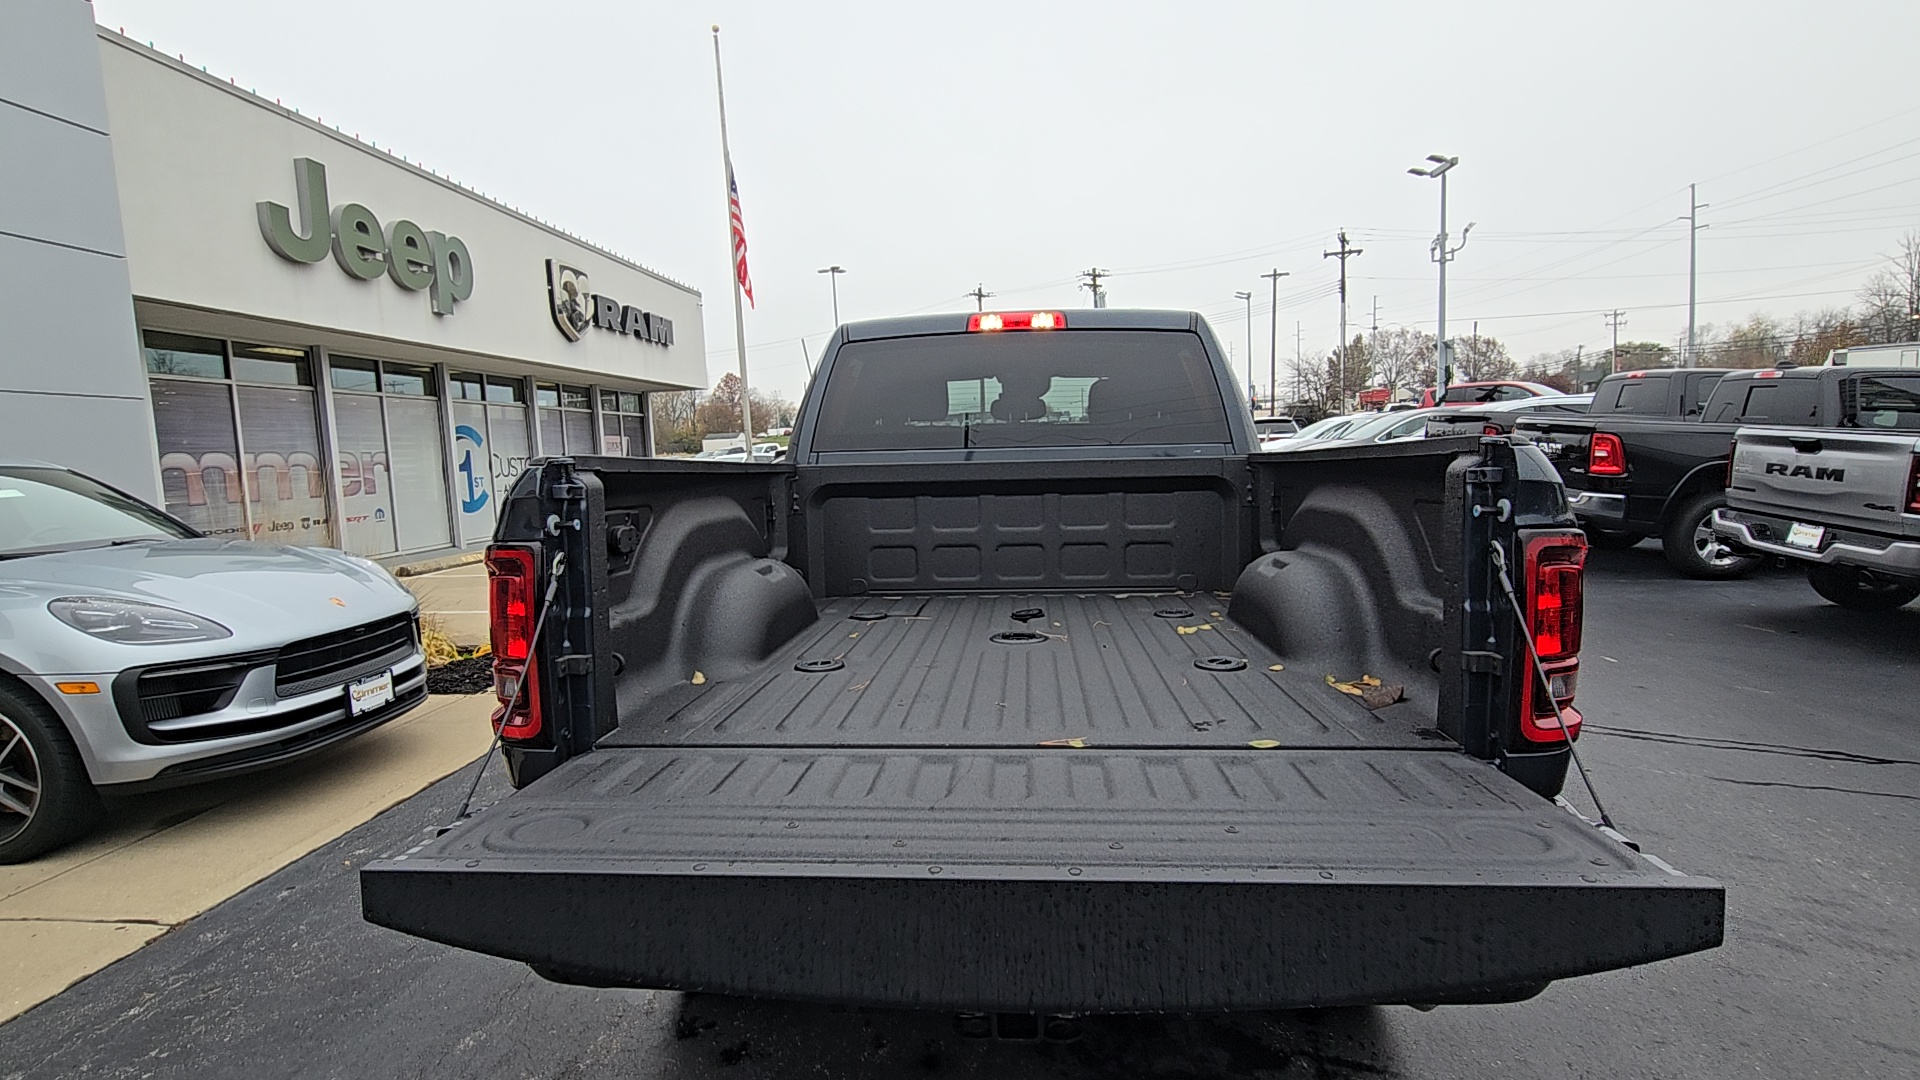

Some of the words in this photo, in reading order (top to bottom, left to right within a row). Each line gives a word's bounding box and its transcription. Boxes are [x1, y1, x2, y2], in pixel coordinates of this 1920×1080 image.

[256, 157, 474, 315] Jeep
[591, 294, 675, 346] RAM
[1529, 441, 1564, 455] AM
[1765, 462, 1846, 483] RAM
[268, 519, 295, 533] Jeep
